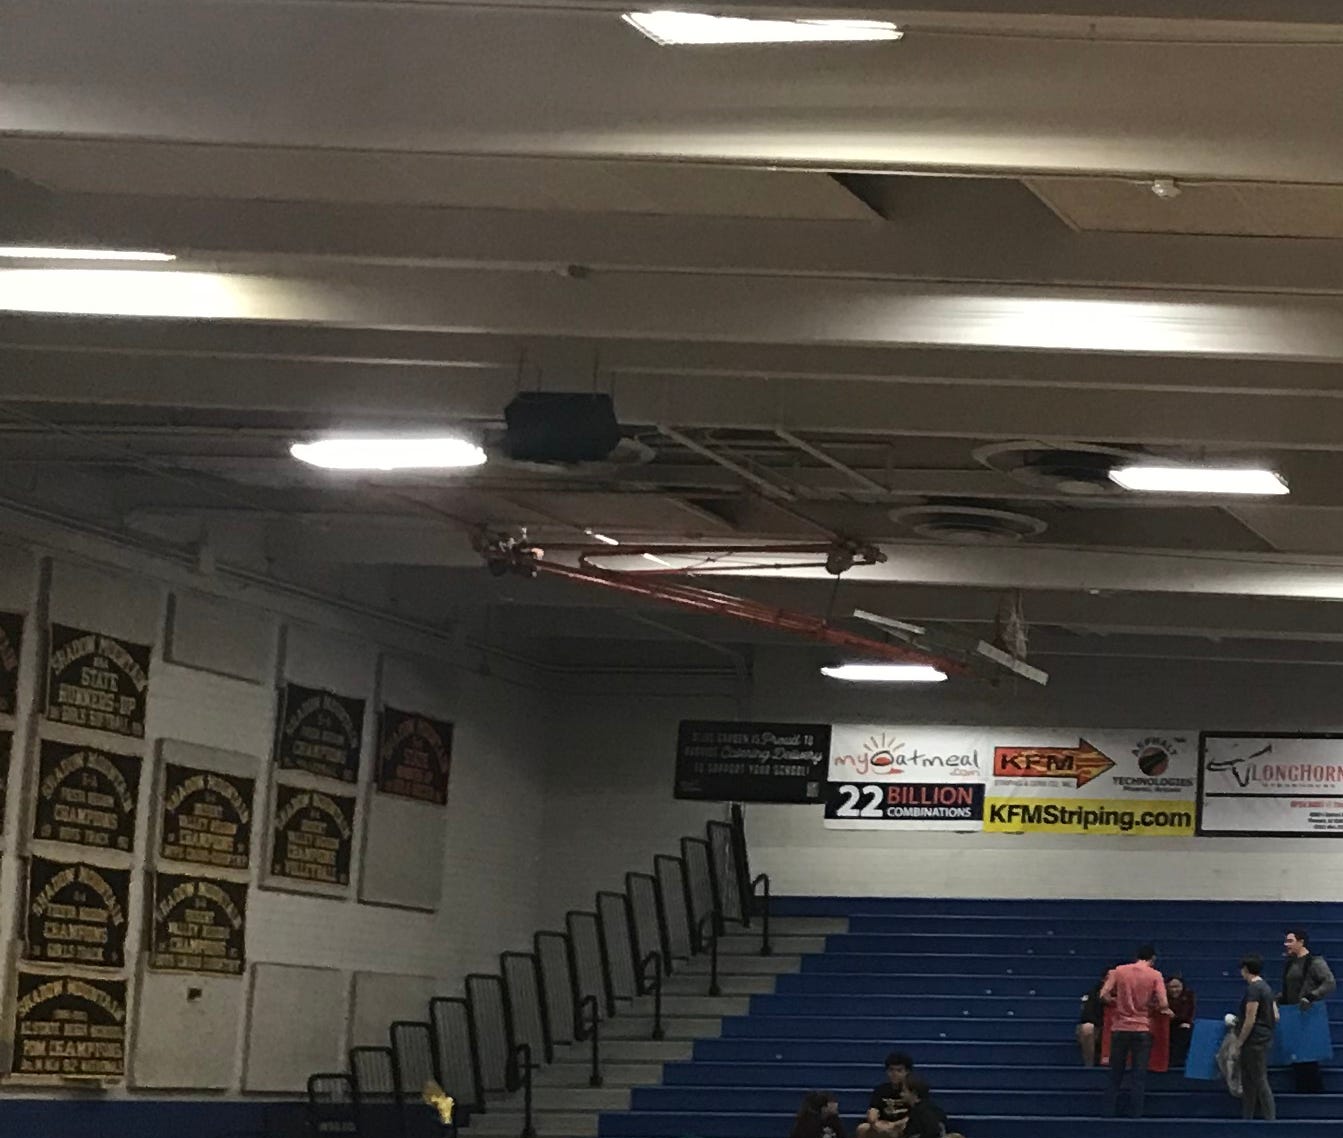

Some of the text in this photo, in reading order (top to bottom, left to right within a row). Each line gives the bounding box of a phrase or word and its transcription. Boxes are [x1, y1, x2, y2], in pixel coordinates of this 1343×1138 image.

[835, 750, 980, 775] myOatmeal
[1001, 754, 1075, 770] KFM
[1112, 776, 1194, 788] TECHNOLOGIES
[837, 784, 974, 817] 22 BILLION
[887, 806, 972, 818] COMBINATIONS
[989, 803, 1192, 832] KFMStriping.com
